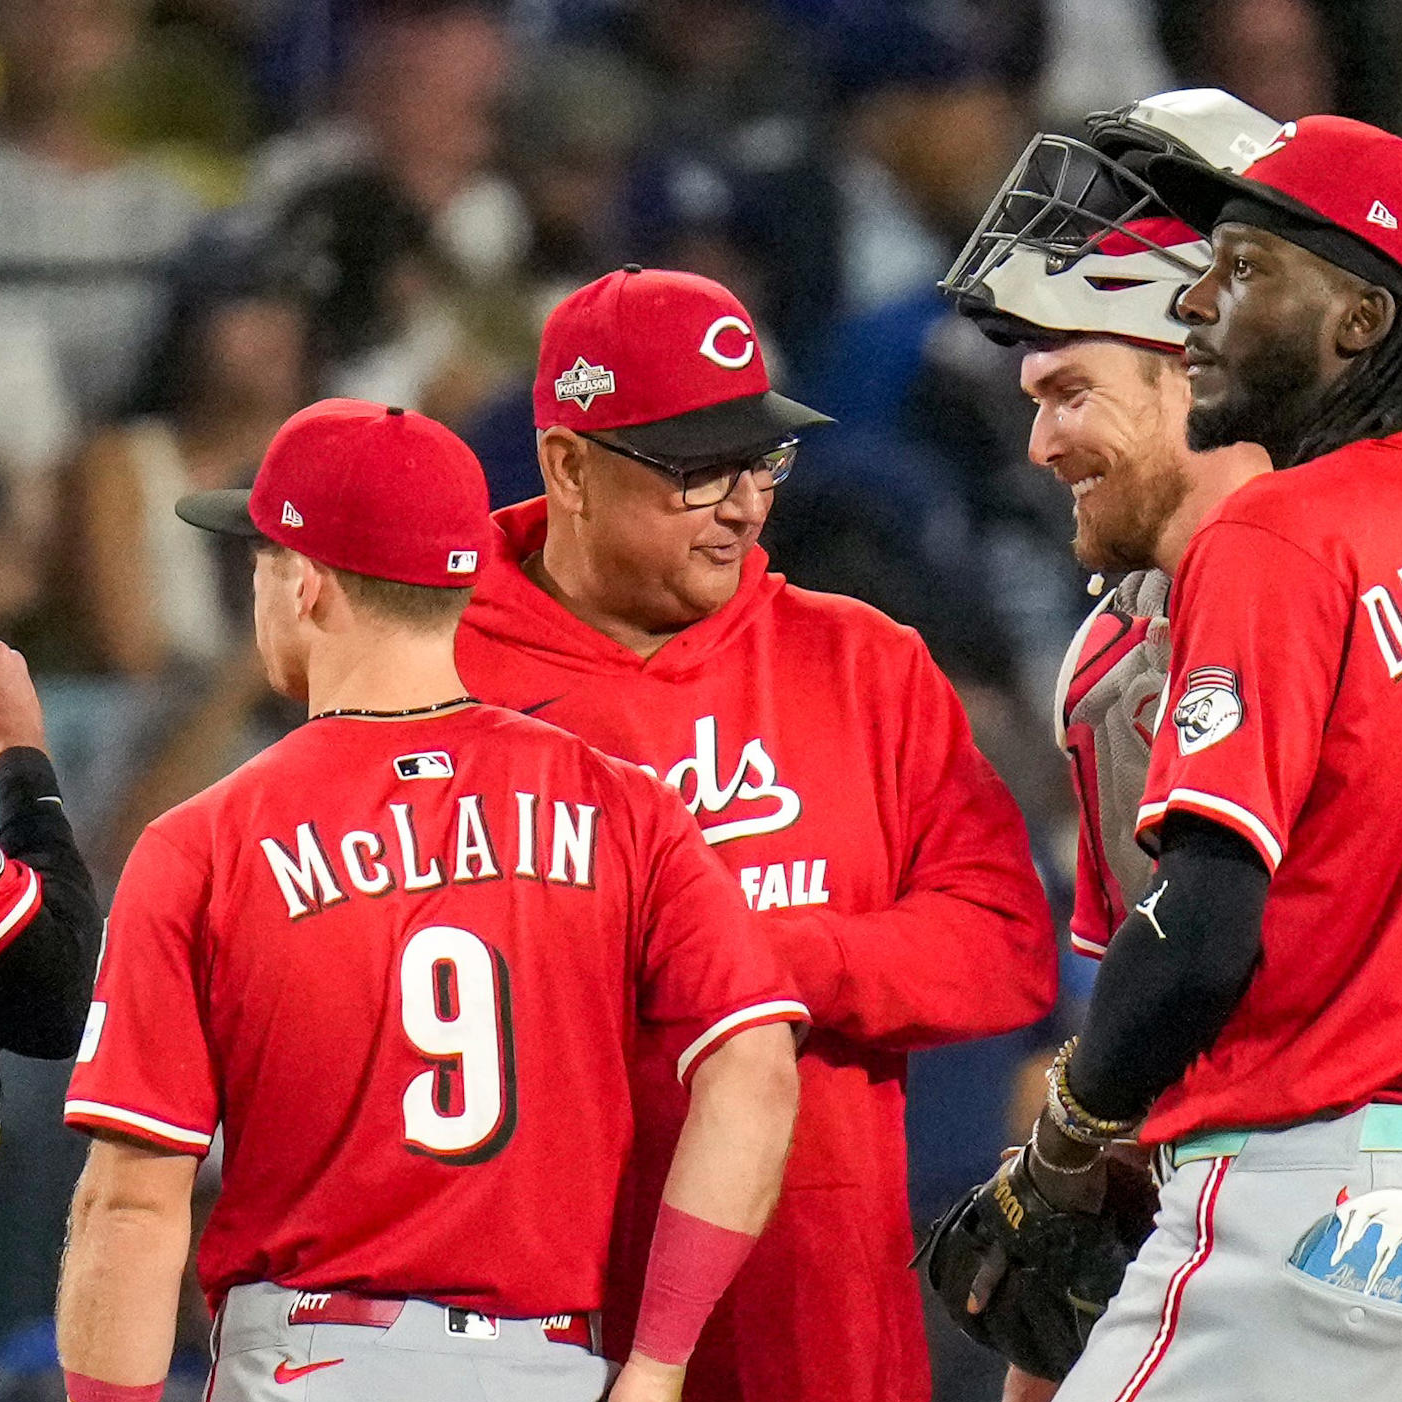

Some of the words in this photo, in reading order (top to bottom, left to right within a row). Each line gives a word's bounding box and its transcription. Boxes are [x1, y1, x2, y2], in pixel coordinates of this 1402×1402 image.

[556, 378, 611, 396] POSTSEASON
[699, 316, 754, 370] C
[260, 790, 600, 921] McLAIN
[401, 925, 516, 1165] 9
